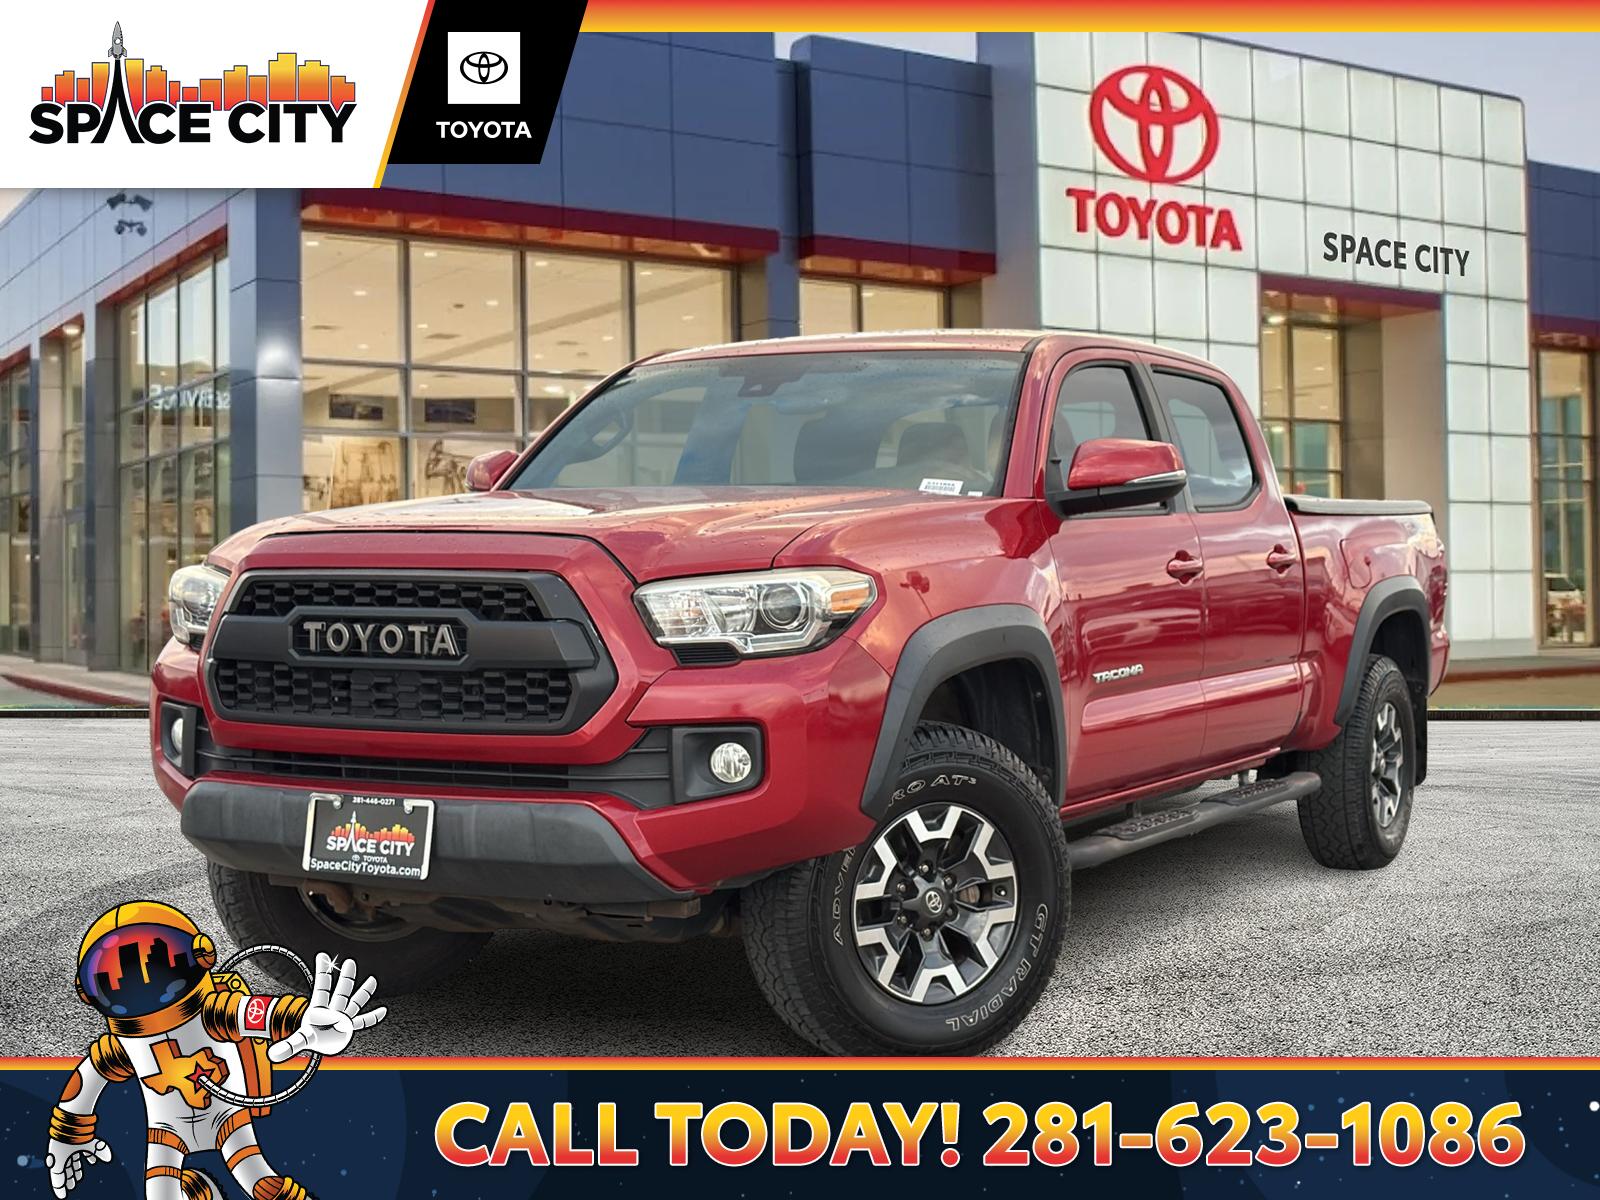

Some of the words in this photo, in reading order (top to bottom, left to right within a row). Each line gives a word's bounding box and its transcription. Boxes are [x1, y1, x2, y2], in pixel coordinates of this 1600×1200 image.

[1066, 187, 1243, 251] TOYOTA
[1323, 231, 1407, 270] SPACE
[1414, 243, 1470, 277] CITY
[303, 620, 460, 657] TOYOTA
[1092, 663, 1144, 684] TACOMA
[326, 835, 377, 854] SPACE
[379, 840, 415, 857] CITY
[363, 854, 388, 864] TOYOTA
[310, 858, 421, 877] SpaceCityToyota.com
[1030, 903, 1048, 958] GT
[945, 958, 1032, 1032] RADIAL
